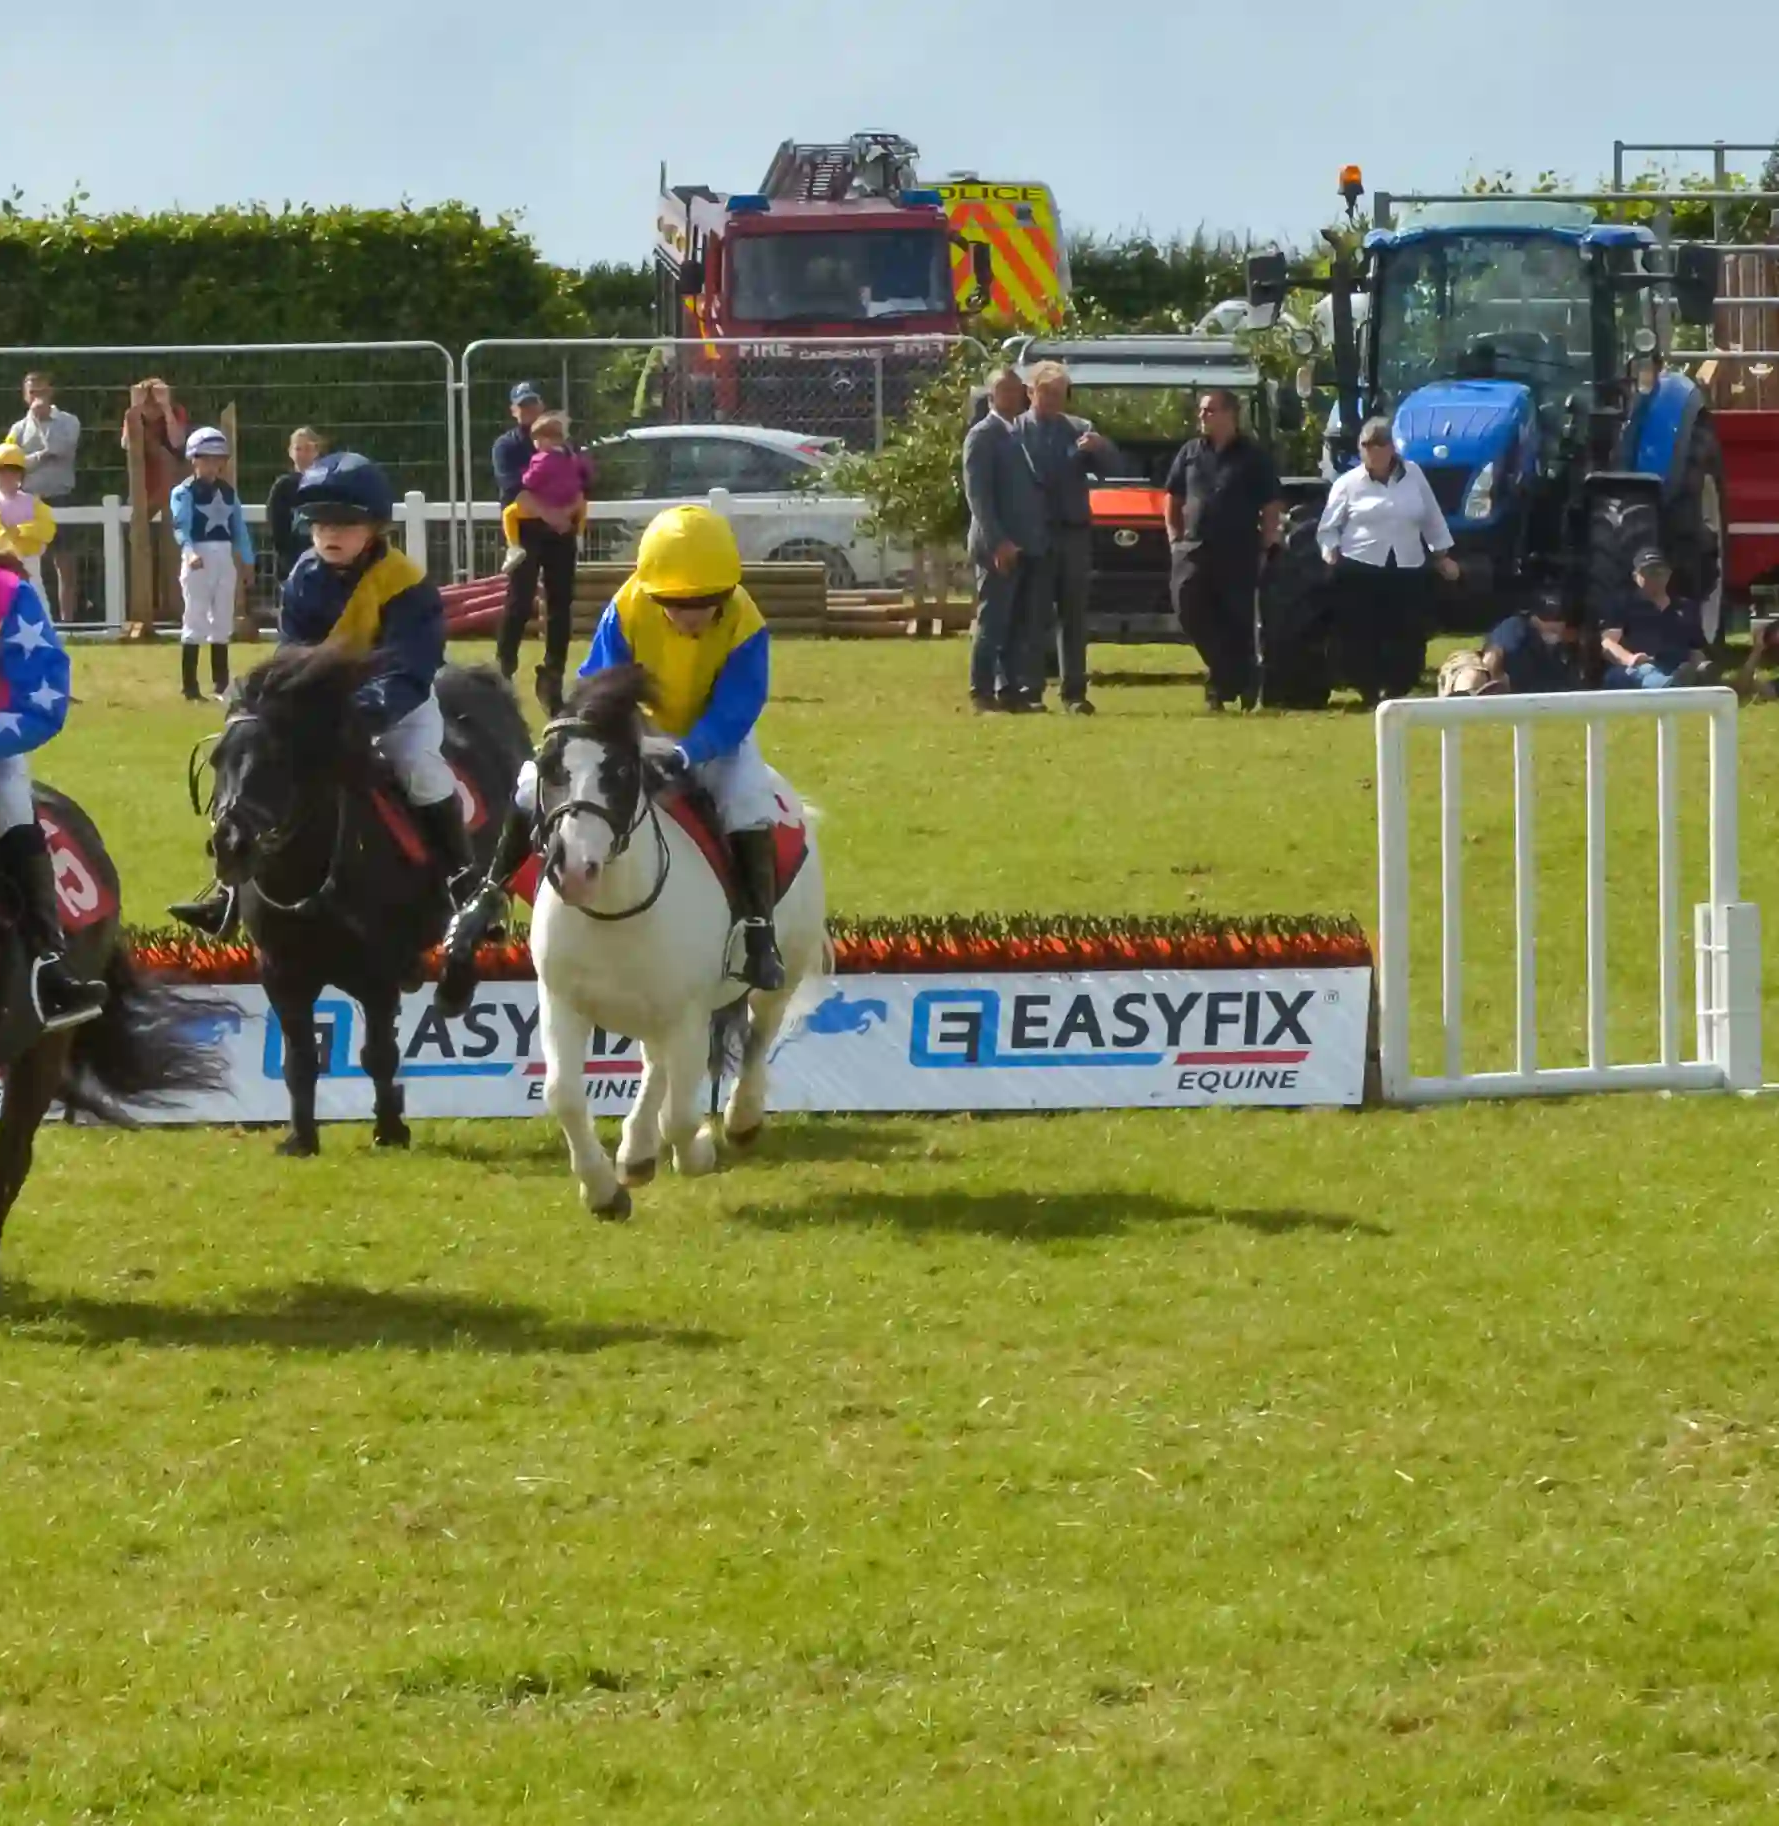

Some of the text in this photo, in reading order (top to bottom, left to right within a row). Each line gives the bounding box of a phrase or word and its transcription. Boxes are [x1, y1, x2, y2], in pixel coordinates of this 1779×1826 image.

[937, 187, 1042, 200] OLICE
[738, 343, 792, 357] FIRE
[1011, 990, 1317, 1050] EASYFIX
[1176, 1069, 1300, 1094] EQUINE
